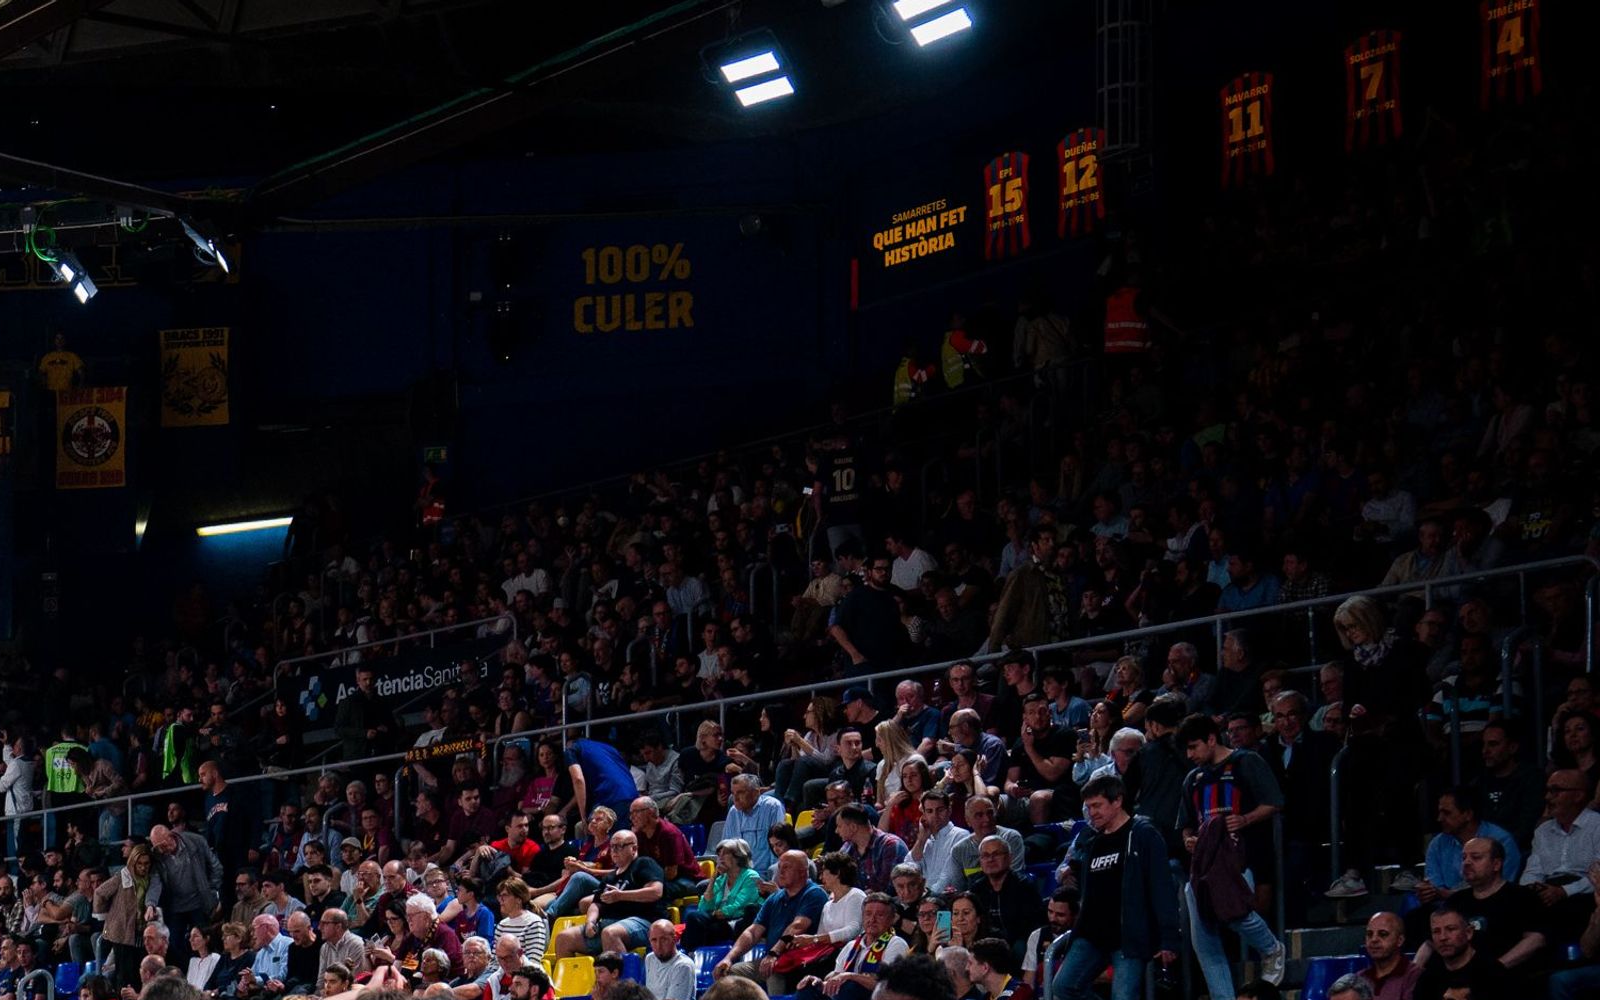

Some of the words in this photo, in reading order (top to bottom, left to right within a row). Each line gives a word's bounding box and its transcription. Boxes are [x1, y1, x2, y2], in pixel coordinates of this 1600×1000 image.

[1496, 16, 1524, 55] 4
[1360, 61, 1384, 100] 7
[1228, 101, 1264, 143] 11
[1063, 155, 1098, 196] 12
[892, 199, 947, 225] SAMARRETES
[989, 177, 1023, 218] 15
[873, 226, 903, 251] QUE
[905, 215, 937, 240] HAN
[940, 205, 967, 229] FET
[581, 242, 691, 285] 100%
[884, 231, 955, 267] HISTÒRIA
[574, 290, 695, 333] CULER
[832, 467, 856, 492] 10
